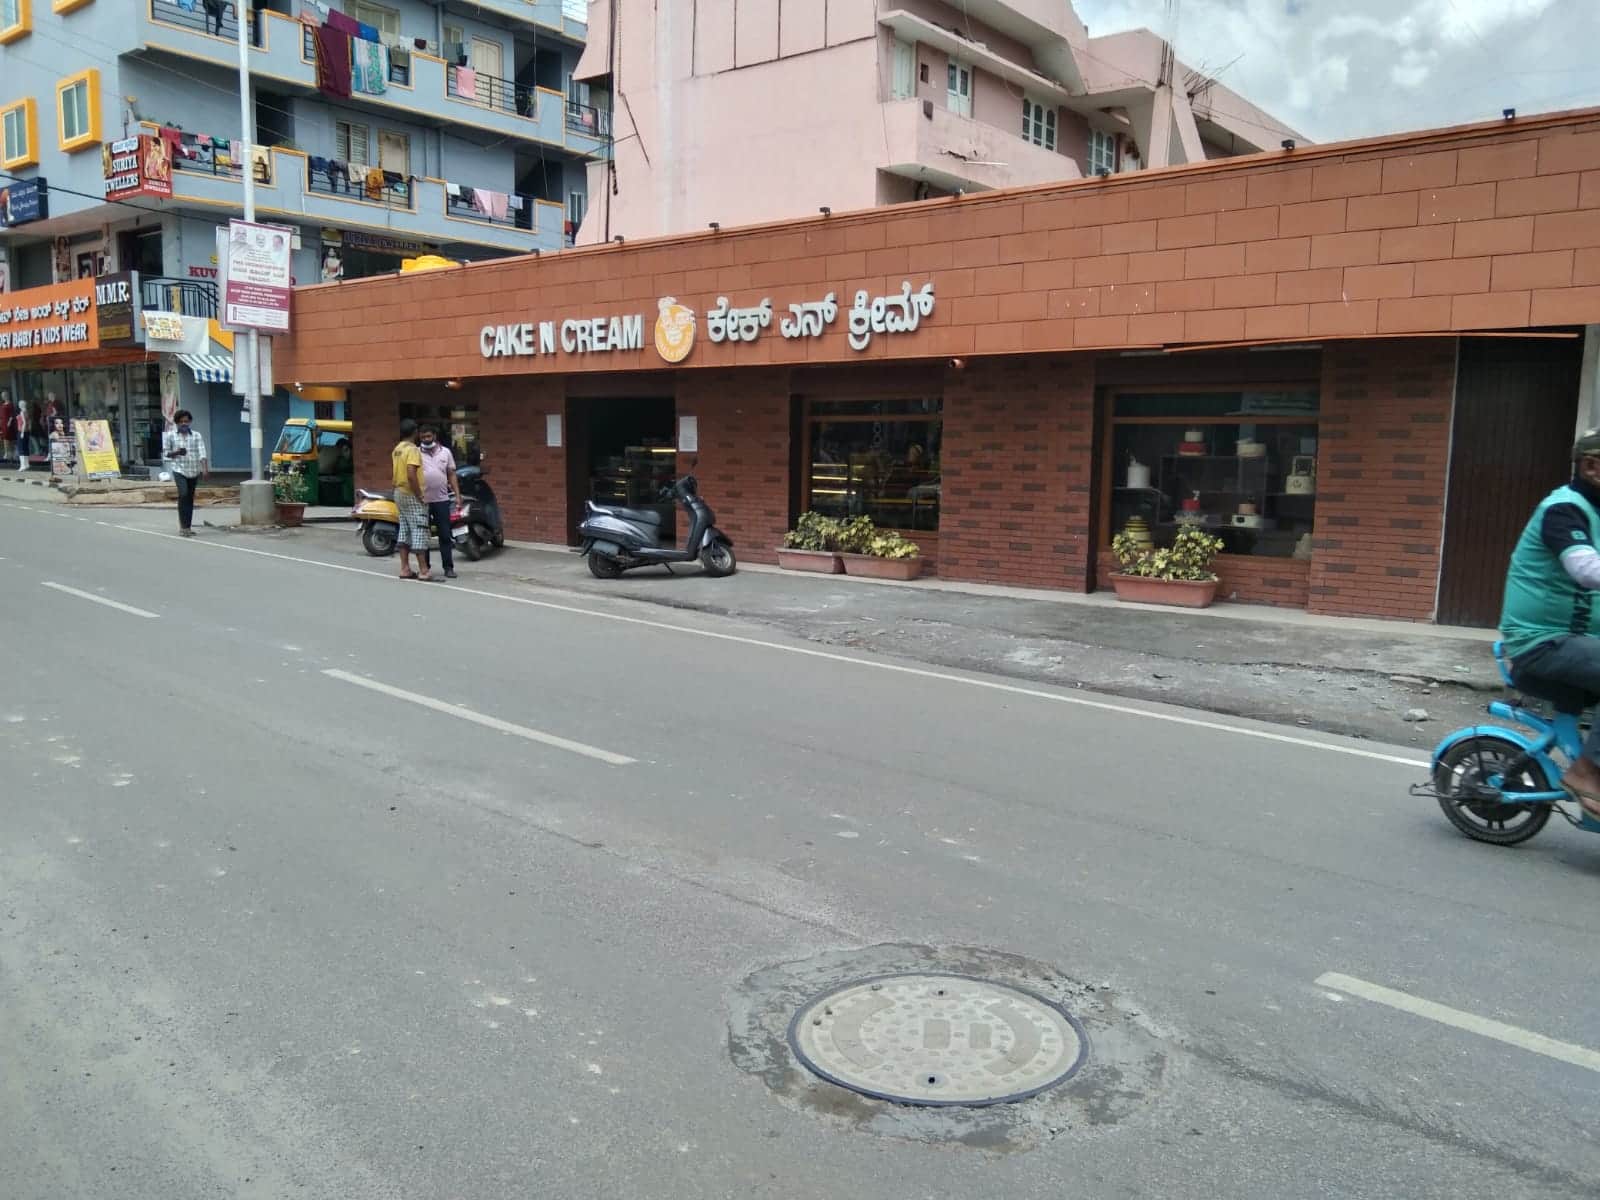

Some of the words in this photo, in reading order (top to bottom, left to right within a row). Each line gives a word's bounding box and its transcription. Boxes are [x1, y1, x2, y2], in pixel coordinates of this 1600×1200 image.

[12, 330, 33, 348] BABY
[41, 326, 61, 344] KIDS
[62, 322, 88, 343] WEAR
[480, 323, 536, 358] CAKE
[539, 320, 556, 354] N
[561, 314, 645, 353] CREAM
[707, 296, 772, 342] ಕೇಕ್
[780, 292, 837, 338] ಎನ್
[848, 281, 934, 350] ಕ್ರೀಮ್
